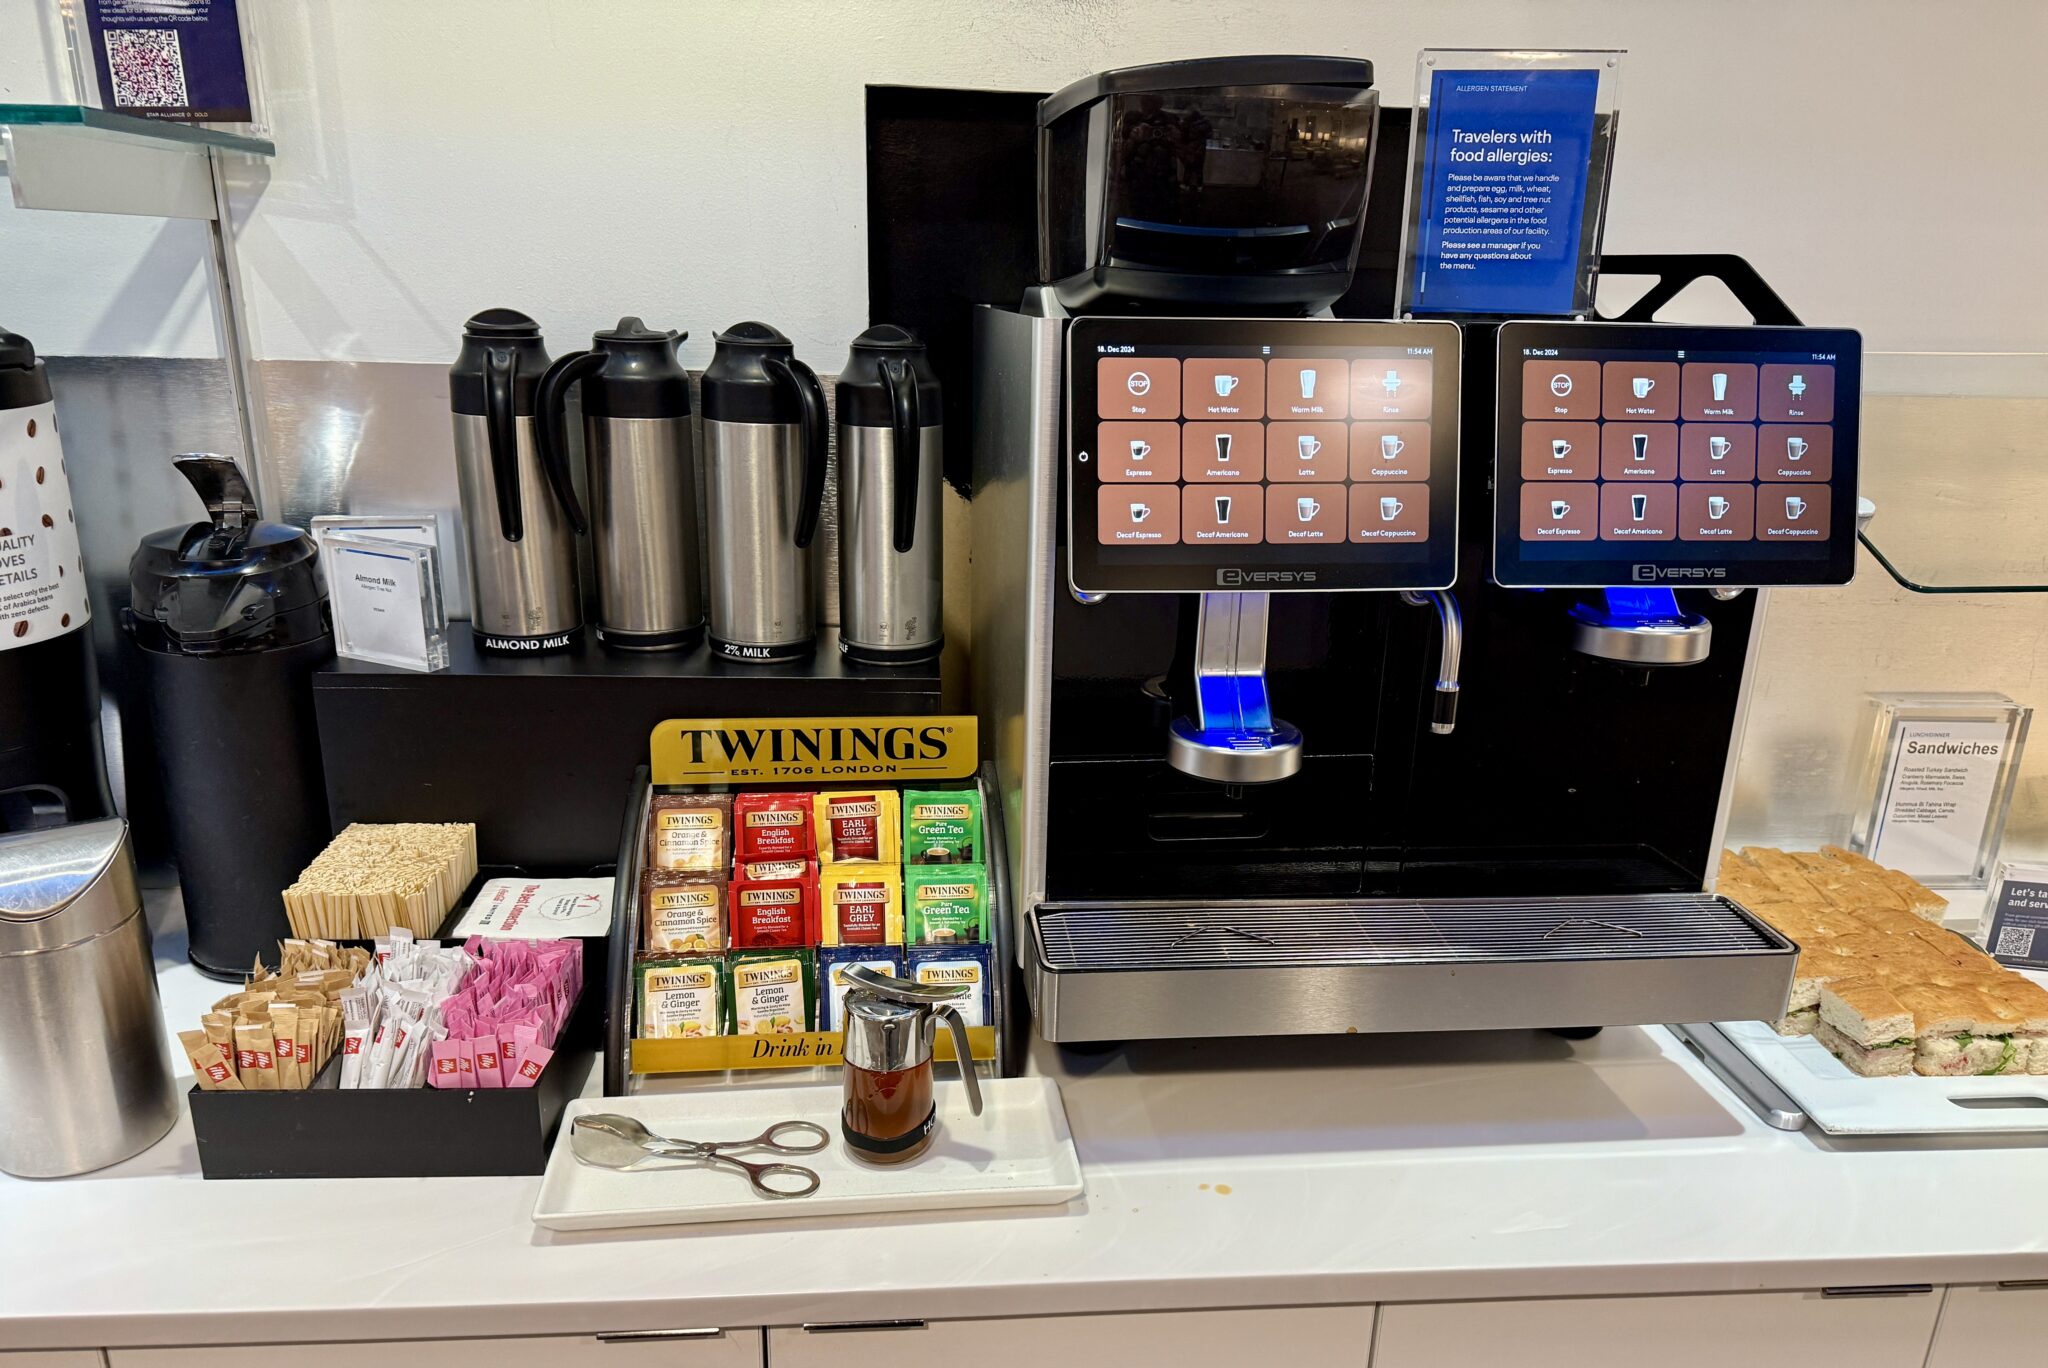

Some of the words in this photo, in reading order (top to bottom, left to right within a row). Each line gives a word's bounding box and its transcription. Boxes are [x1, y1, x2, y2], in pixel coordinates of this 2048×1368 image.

[1452, 129, 1517, 143] Travelers
[1520, 130, 1552, 143] with
[1450, 148, 1484, 162] food
[1487, 148, 1553, 165] allergies:
[1535, 174, 1559, 182] handle
[1447, 184, 1461, 192] and
[1491, 186, 1507, 194] egg,
[1527, 185, 1551, 193] wheat,
[1446, 195, 1477, 203] shellfish,
[1445, 206, 1479, 214] products,
[1444, 216, 1475, 224] potential
[1477, 217, 1508, 225] allergens
[1443, 227, 1482, 235] production
[1526, 227, 1549, 236] facility.
[1131, 406, 1146, 414] Stop
[1554, 406, 1568, 414] Stop
[1125, 469, 1152, 477] Espresso
[1372, 468, 1407, 476] Cappuccino
[1548, 467, 1572, 475] Espresso
[0, 554, 25, 568] VES
[355, 573, 380, 585] Almond
[382, 577, 396, 587] Milk
[4, 590, 24, 601] select
[13, 599, 36, 608] Arabica
[37, 594, 53, 602] beans
[28, 604, 50, 614] defects.
[486, 638, 540, 650] ALMOND
[543, 635, 570, 649] MILK
[724, 644, 741, 656] 2%
[743, 647, 771, 658] MILK
[1907, 741, 1999, 755] Sandwiches
[773, 767, 813, 775] 1706
[822, 765, 897, 774] LONDON
[831, 804, 876, 813] TWININGS
[919, 806, 964, 815] TWININGS
[666, 815, 713, 825] TWININGS
[751, 813, 798, 822] TWININGS
[842, 819, 867, 828] EARL
[762, 829, 790, 837] English
[842, 827, 866, 836] GREY
[919, 826, 946, 834] Green
[947, 826, 963, 834] Tea
[672, 832, 700, 840] Orange
[659, 839, 699, 847] Cinnamon
[700, 838, 720, 847] Spice
[757, 837, 795, 845] Breakfast
[838, 890, 885, 899] TWININGS
[924, 886, 969, 895] TWININGS
[660, 893, 709, 904] TWININGS
[746, 890, 795, 901] TWININGS
[2008, 899, 2027, 907] and
[757, 907, 786, 916] English
[849, 905, 874, 913] EARL
[924, 906, 951, 914] Green
[953, 905, 970, 914] Tea
[500, 905, 528, 930] Connection
[666, 910, 696, 919] Orange
[849, 914, 874, 922] GREY
[654, 917, 696, 927] Cinnamon
[697, 917, 717, 925] Spice
[752, 915, 791, 924] Breakfast
[926, 970, 973, 979] TWININGS
[655, 974, 705, 986] TWININGS
[756, 986, 784, 996] Lemon
[665, 992, 695, 1000] Lemon
[760, 994, 789, 1004] Ginger
[670, 1000, 700, 1009] Ginger
[277, 1040, 290, 1056] illy
[752, 1038, 810, 1058] Drink
[814, 1038, 834, 1056] in
[240, 1051, 254, 1067] illy
[256, 1052, 268, 1068] illy
[479, 1054, 494, 1068] illy
[210, 1065, 224, 1080] illy
[525, 1062, 539, 1077] illy
